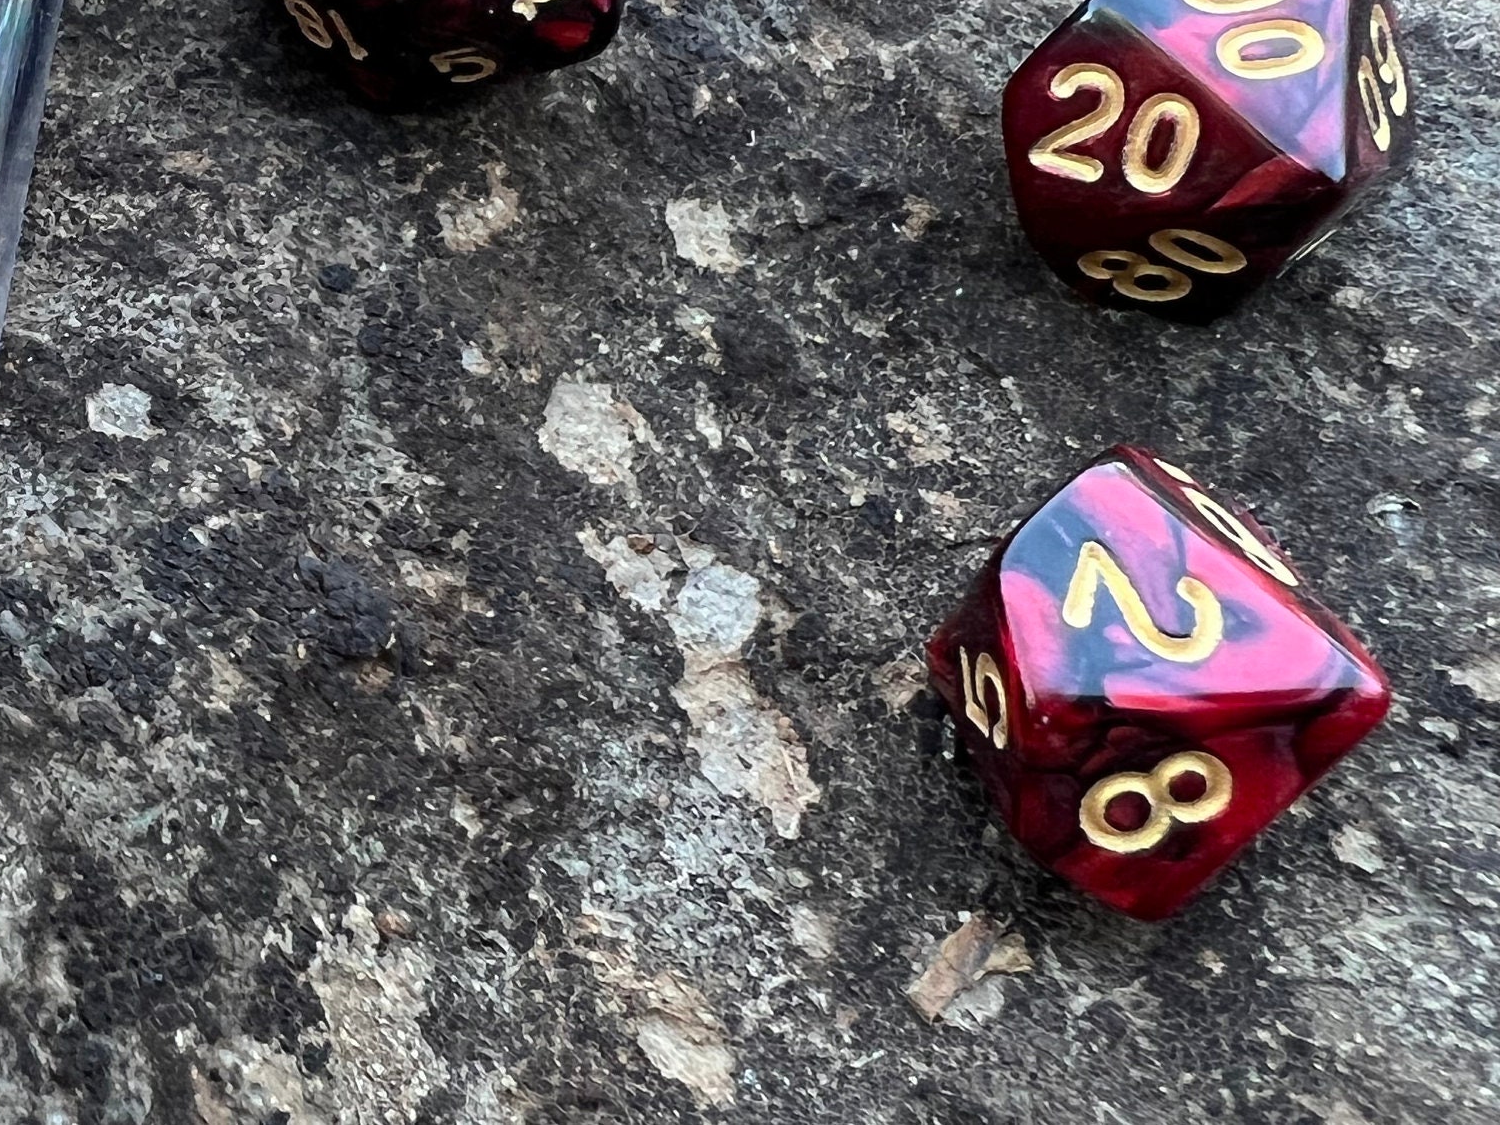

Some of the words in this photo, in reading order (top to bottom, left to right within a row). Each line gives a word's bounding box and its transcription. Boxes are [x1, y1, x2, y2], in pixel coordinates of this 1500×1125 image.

[1028, 61, 1200, 196] 20
[1076, 228, 1248, 303] 80
[1061, 540, 1225, 664] 2
[959, 645, 1009, 751] 5
[1078, 750, 1234, 855] 8
